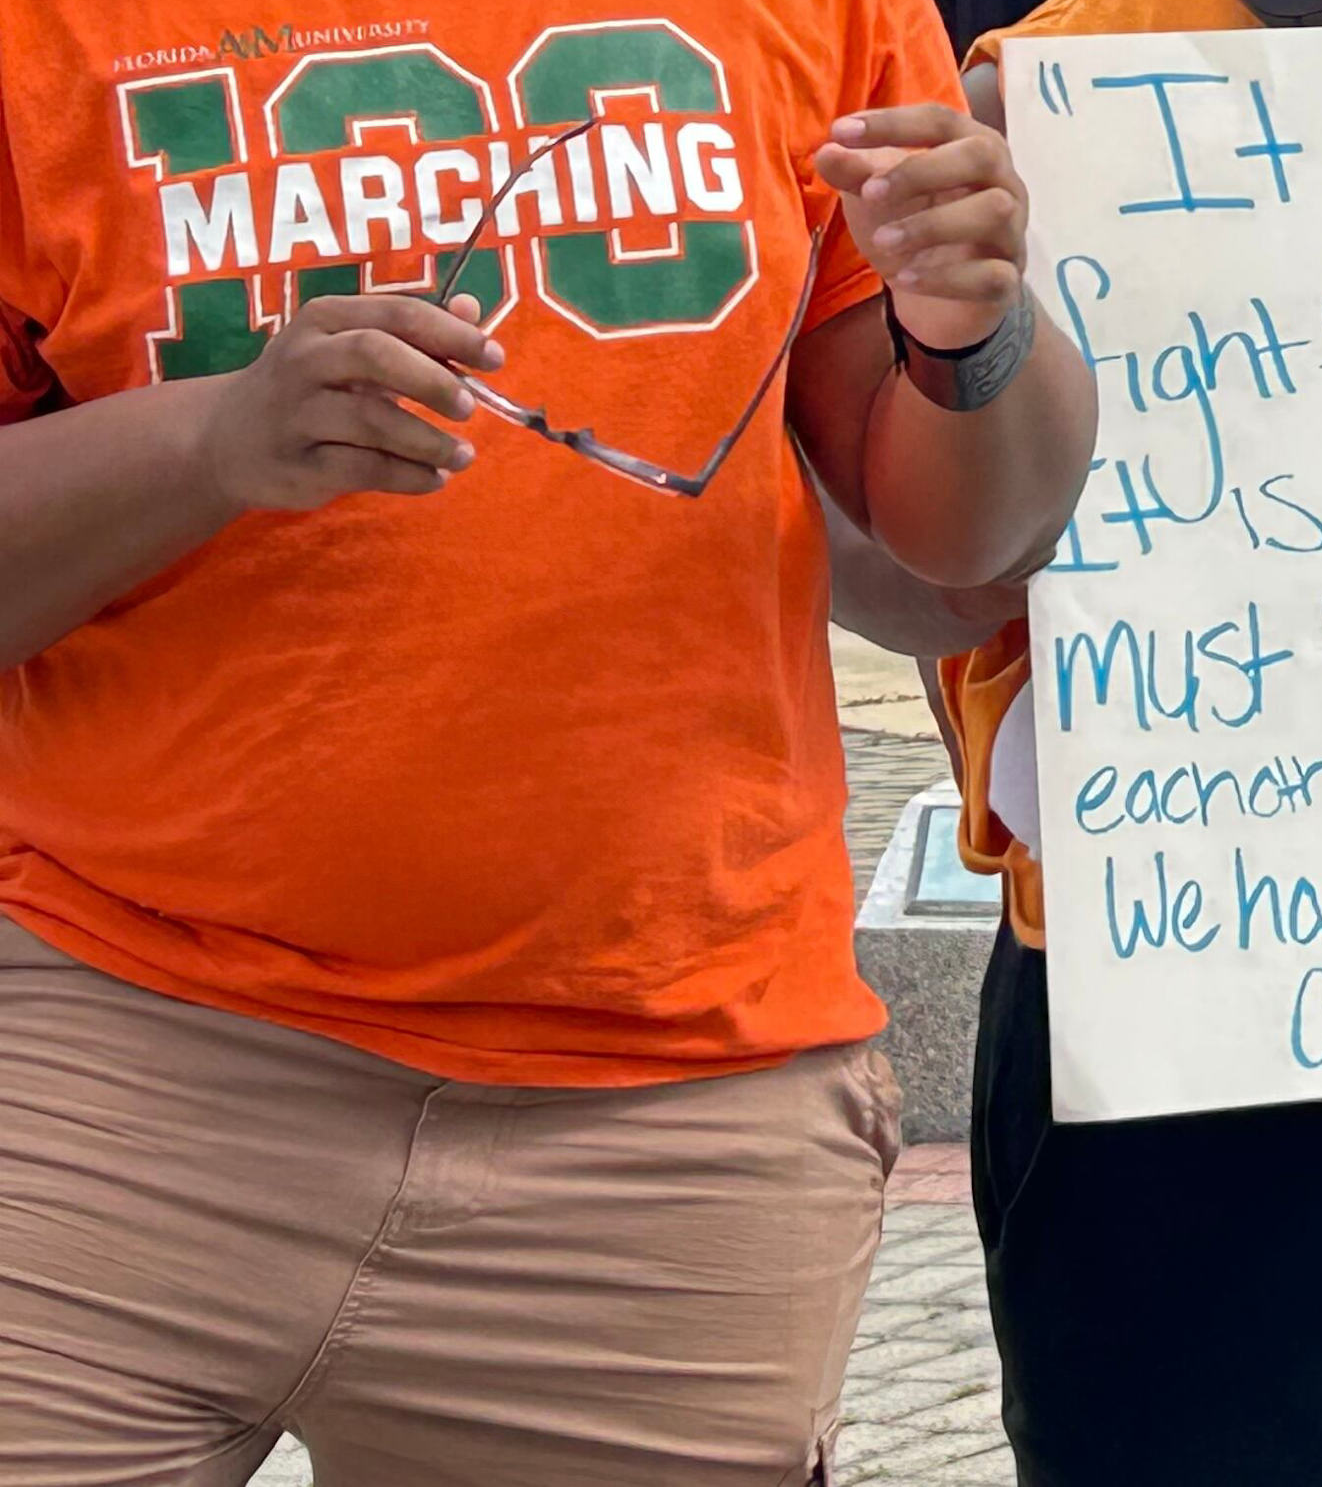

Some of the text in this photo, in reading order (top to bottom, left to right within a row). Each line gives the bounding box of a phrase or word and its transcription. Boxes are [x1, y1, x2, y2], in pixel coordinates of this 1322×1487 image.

[113, 44, 216, 73] FLORIDA
[293, 18, 430, 49] UNIVERSITY
[158, 117, 745, 278] MARCHING
[1056, 255, 1312, 524] fight
